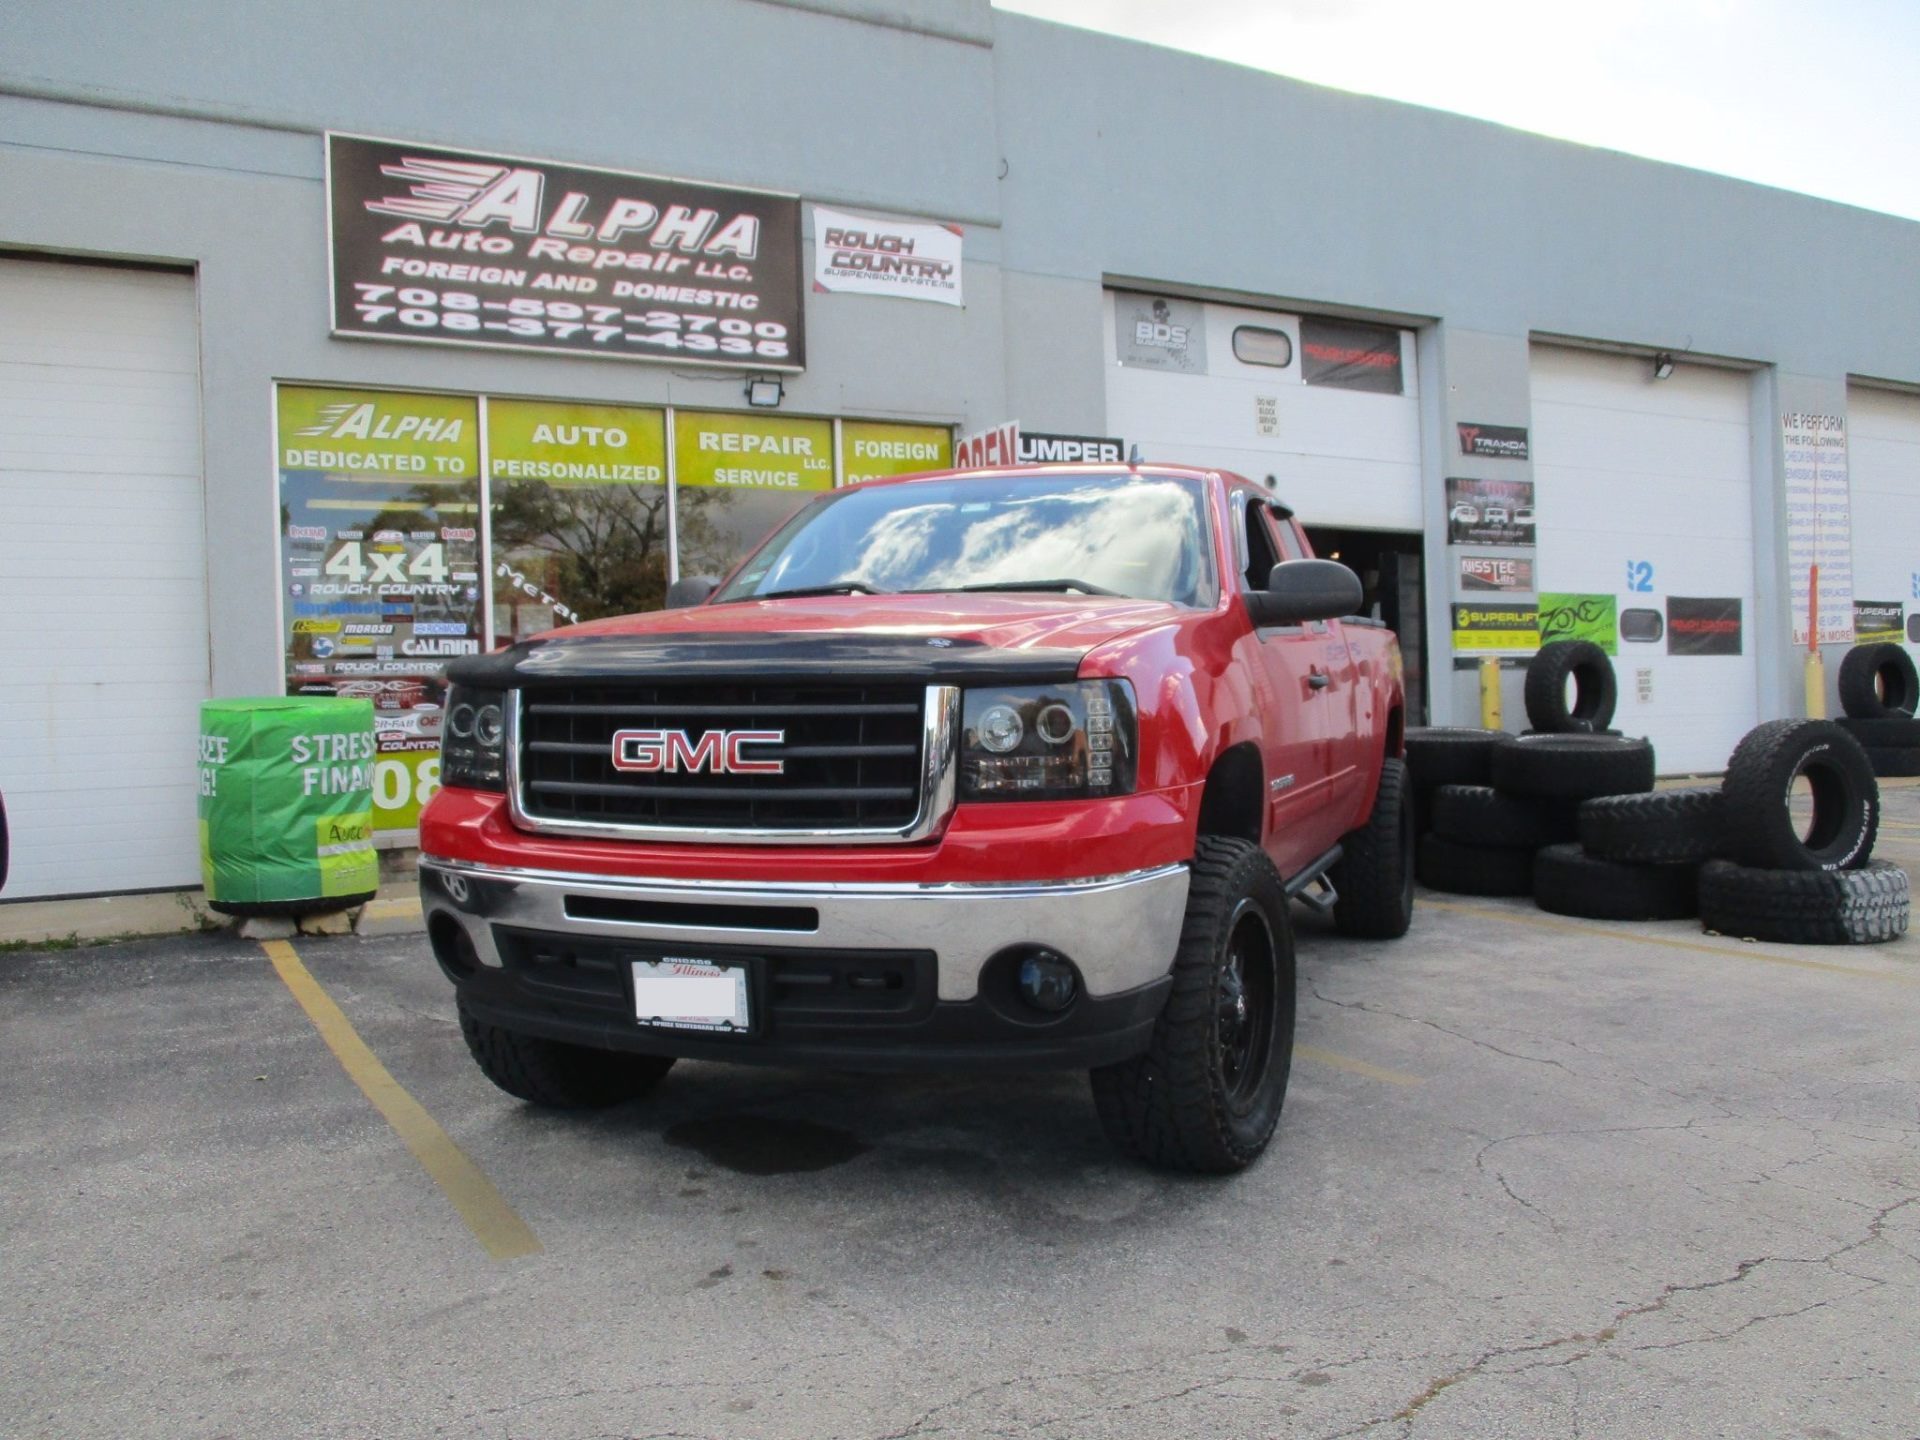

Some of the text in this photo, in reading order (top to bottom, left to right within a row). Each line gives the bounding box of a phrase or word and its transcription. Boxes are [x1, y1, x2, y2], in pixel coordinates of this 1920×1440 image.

[459, 168, 760, 260] ALPHA
[824, 227, 915, 254] ROUGH
[381, 222, 753, 282] Auto Repair LLC.
[831, 250, 954, 280] COUNTRY
[381, 256, 759, 310] FOREIGN AND DOMESTIC
[824, 268, 955, 289] SUSPENSION SYSTEMS
[354, 282, 788, 339] 708-597-2700
[355, 303, 789, 358] 708-377-4335
[1136, 321, 1187, 343] BDS
[331, 403, 463, 442] ALPHA
[1783, 412, 1844, 432] WE PERFORM
[532, 424, 628, 448] AUTO
[700, 431, 813, 456] REPAIR
[1785, 434, 1845, 448] THE FOLLOWING
[286, 449, 465, 473] DEDICATED TO
[855, 440, 939, 461] FOREIGN
[492, 459, 661, 481] PERSONALIZED
[714, 468, 799, 487] SERVICE
[325, 541, 449, 583] 4x4
[1636, 560, 1654, 592] 2
[310, 583, 461, 596] ROUGH COUNTRY
[1470, 612, 1539, 623] SUPERLIFT
[344, 624, 394, 634] MOROSO
[1801, 631, 1826, 642] MCH
[402, 639, 479, 656] CALMINI
[335, 662, 380, 671] ROUGH
[383, 662, 444, 672] COUNTRY
[381, 741, 441, 751] COUNTRY
[612, 728, 785, 774] GMC
[662, 957, 712, 966] CHICAGO
